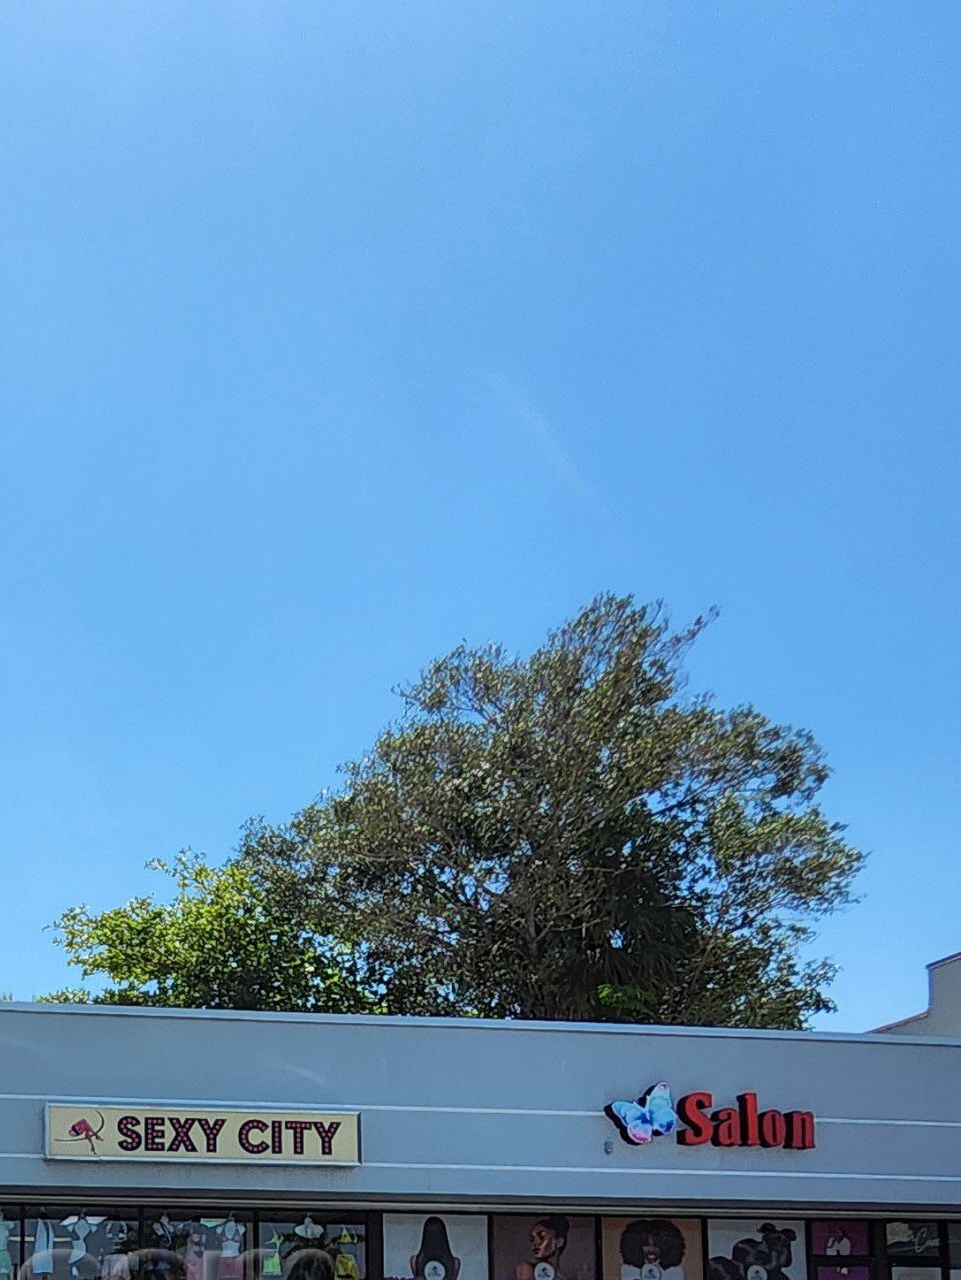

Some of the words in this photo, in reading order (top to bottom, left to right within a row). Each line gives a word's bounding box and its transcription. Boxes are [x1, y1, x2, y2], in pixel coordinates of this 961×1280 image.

[116, 1115, 227, 1153] SEXY
[238, 1119, 342, 1156] CITY
[676, 1092, 815, 1150] Salon
